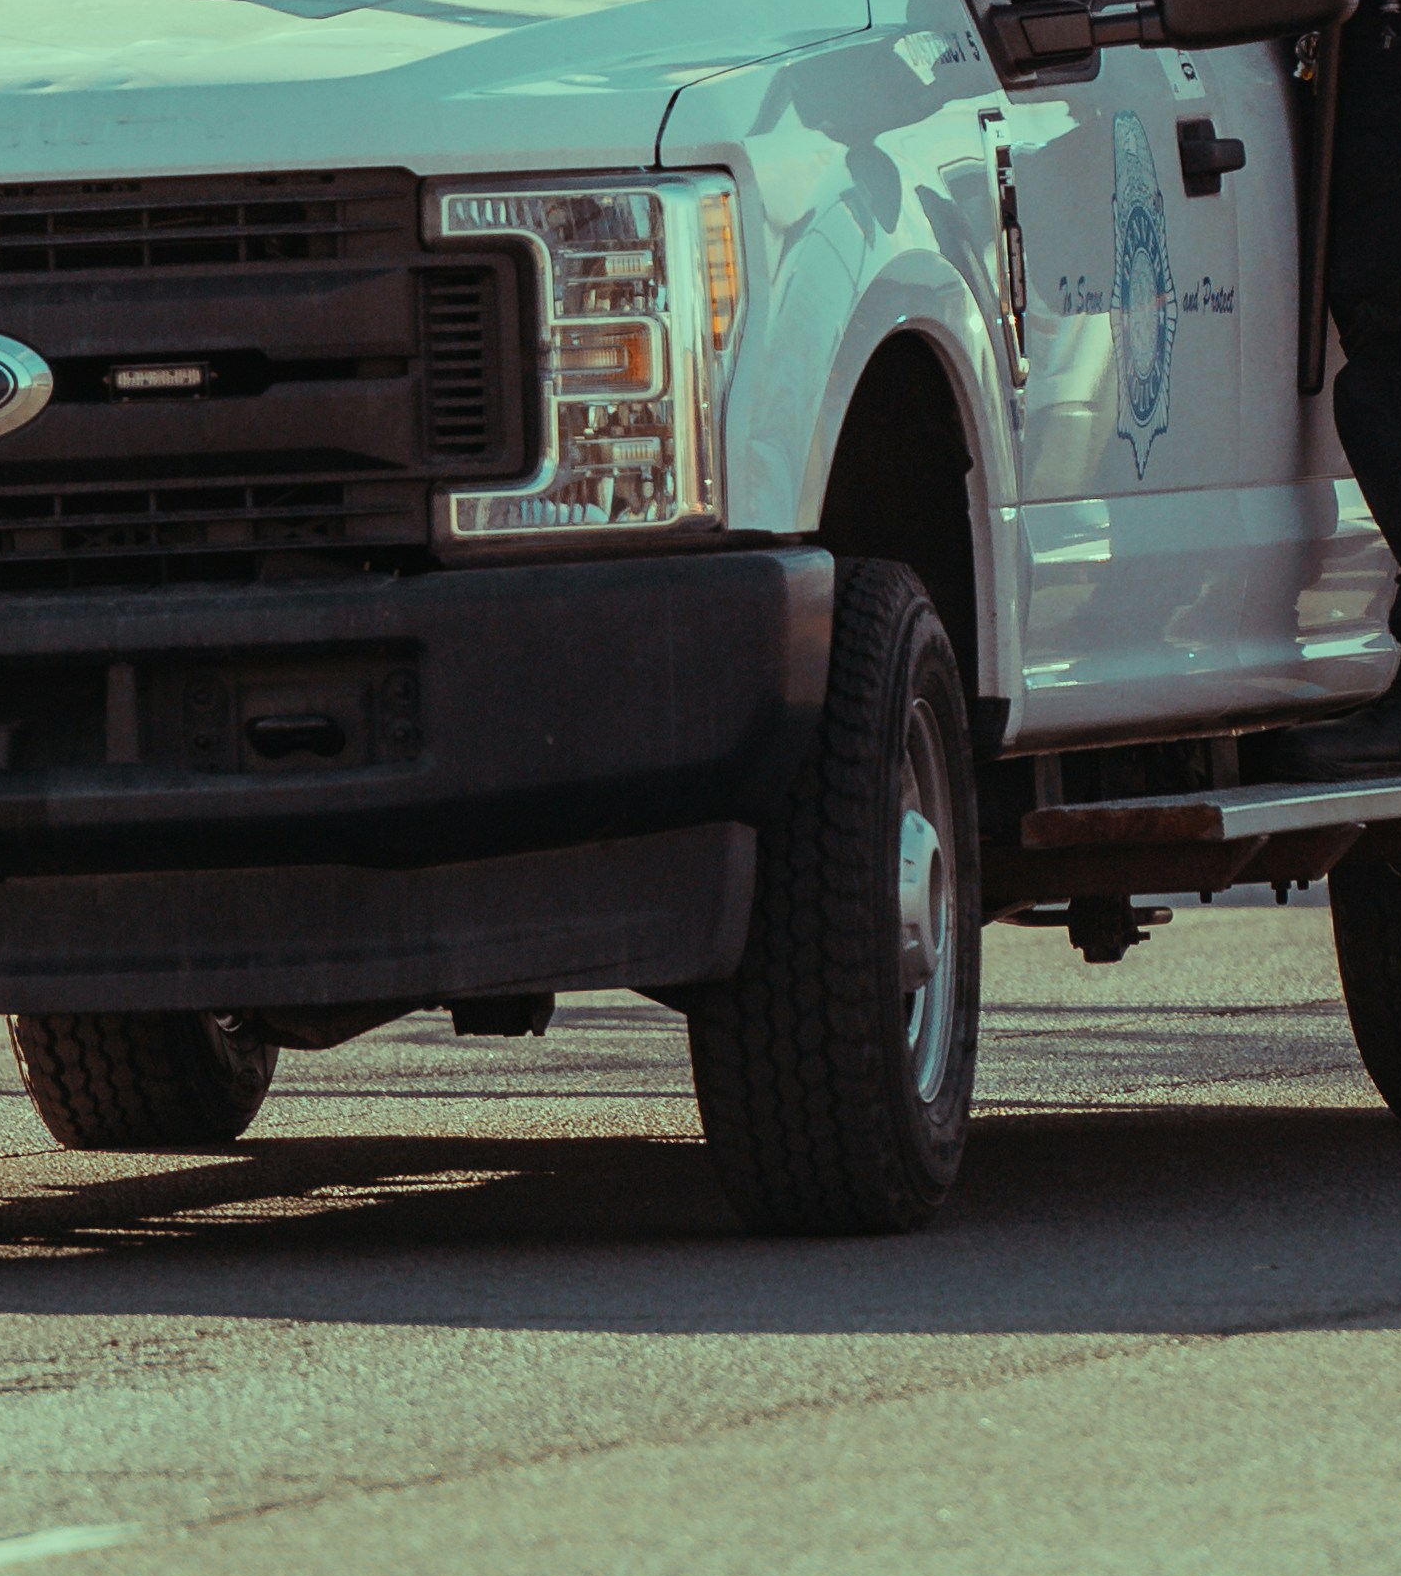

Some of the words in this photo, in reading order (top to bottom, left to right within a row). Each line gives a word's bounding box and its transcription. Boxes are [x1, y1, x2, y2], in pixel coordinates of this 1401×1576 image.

[966, 30, 981, 61] 5
[1059, 275, 1073, 314] To
[1183, 280, 1200, 313] and
[1202, 275, 1235, 315] Protect
